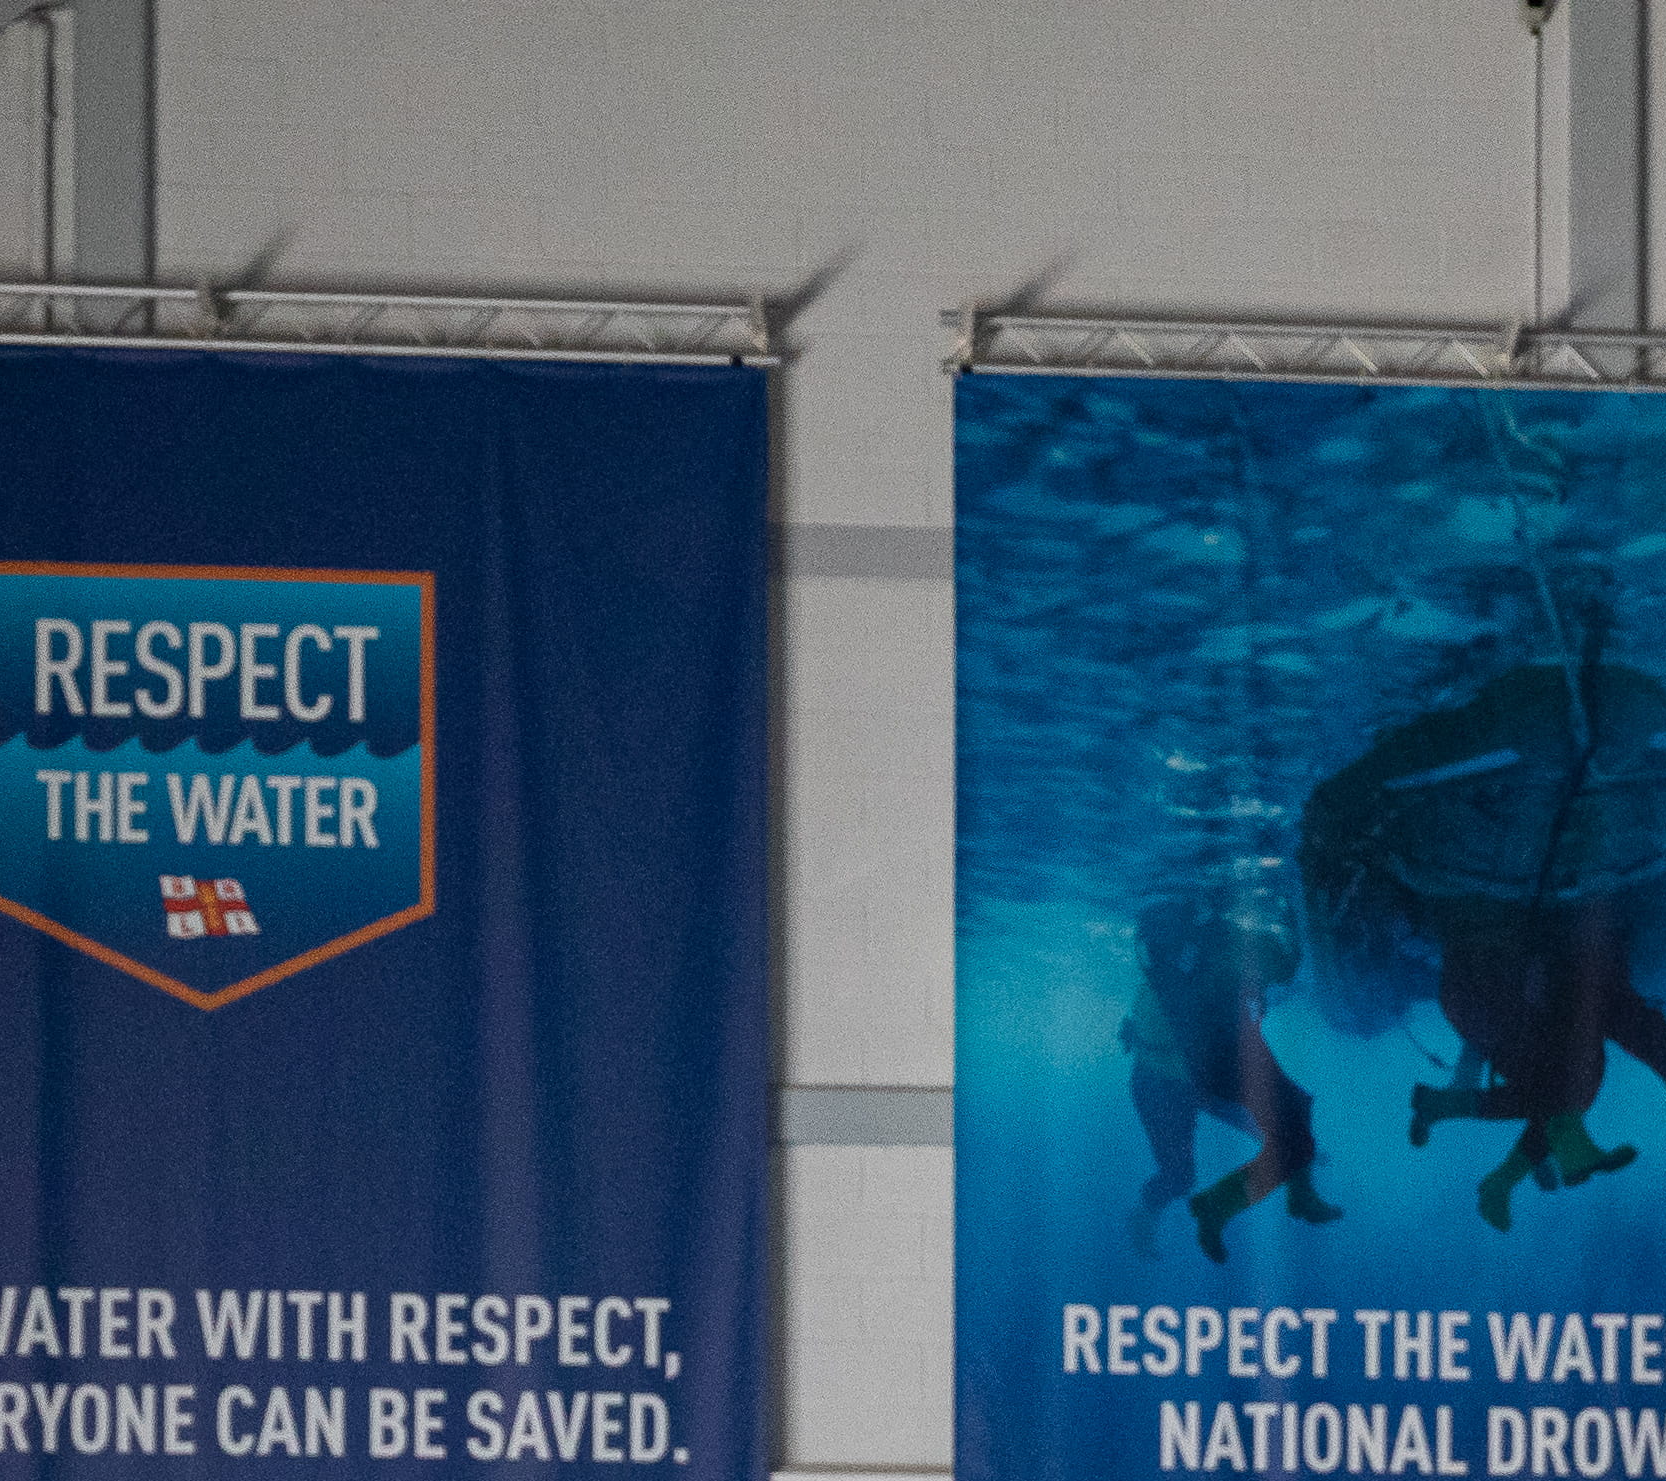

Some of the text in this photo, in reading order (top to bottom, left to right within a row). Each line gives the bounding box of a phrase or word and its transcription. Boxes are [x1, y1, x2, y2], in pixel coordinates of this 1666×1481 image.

[36, 618, 379, 722] RESPECT
[36, 770, 378, 848] THE WATER
[196, 1290, 366, 1361] WITH
[390, 1293, 680, 1378] RESPECT,
[1063, 1304, 1337, 1378] RESPECT
[1355, 1310, 1470, 1381] THE
[217, 1385, 345, 1457] CAN
[369, 1388, 446, 1459] BE
[467, 1390, 689, 1464] SAVED.
[1160, 1401, 1468, 1475] NATIONAL
